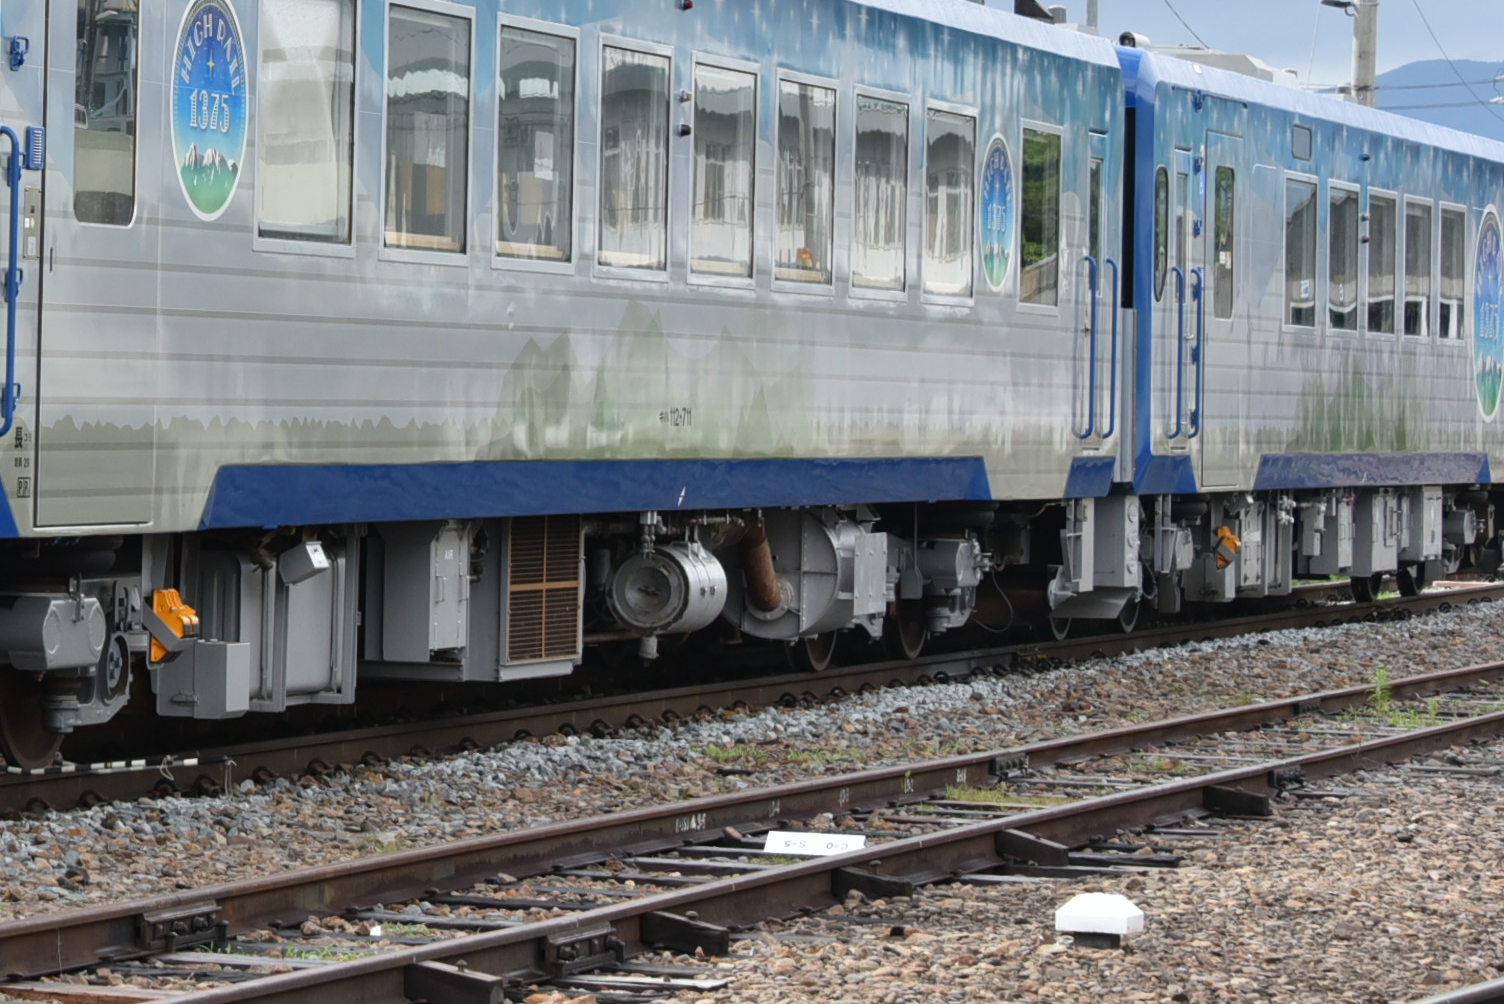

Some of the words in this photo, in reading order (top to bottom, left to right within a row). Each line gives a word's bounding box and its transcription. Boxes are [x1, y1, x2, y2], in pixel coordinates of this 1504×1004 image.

[180, 13, 213, 85] HIGH
[217, 18, 240, 95] RAIL
[189, 88, 231, 133] 1375
